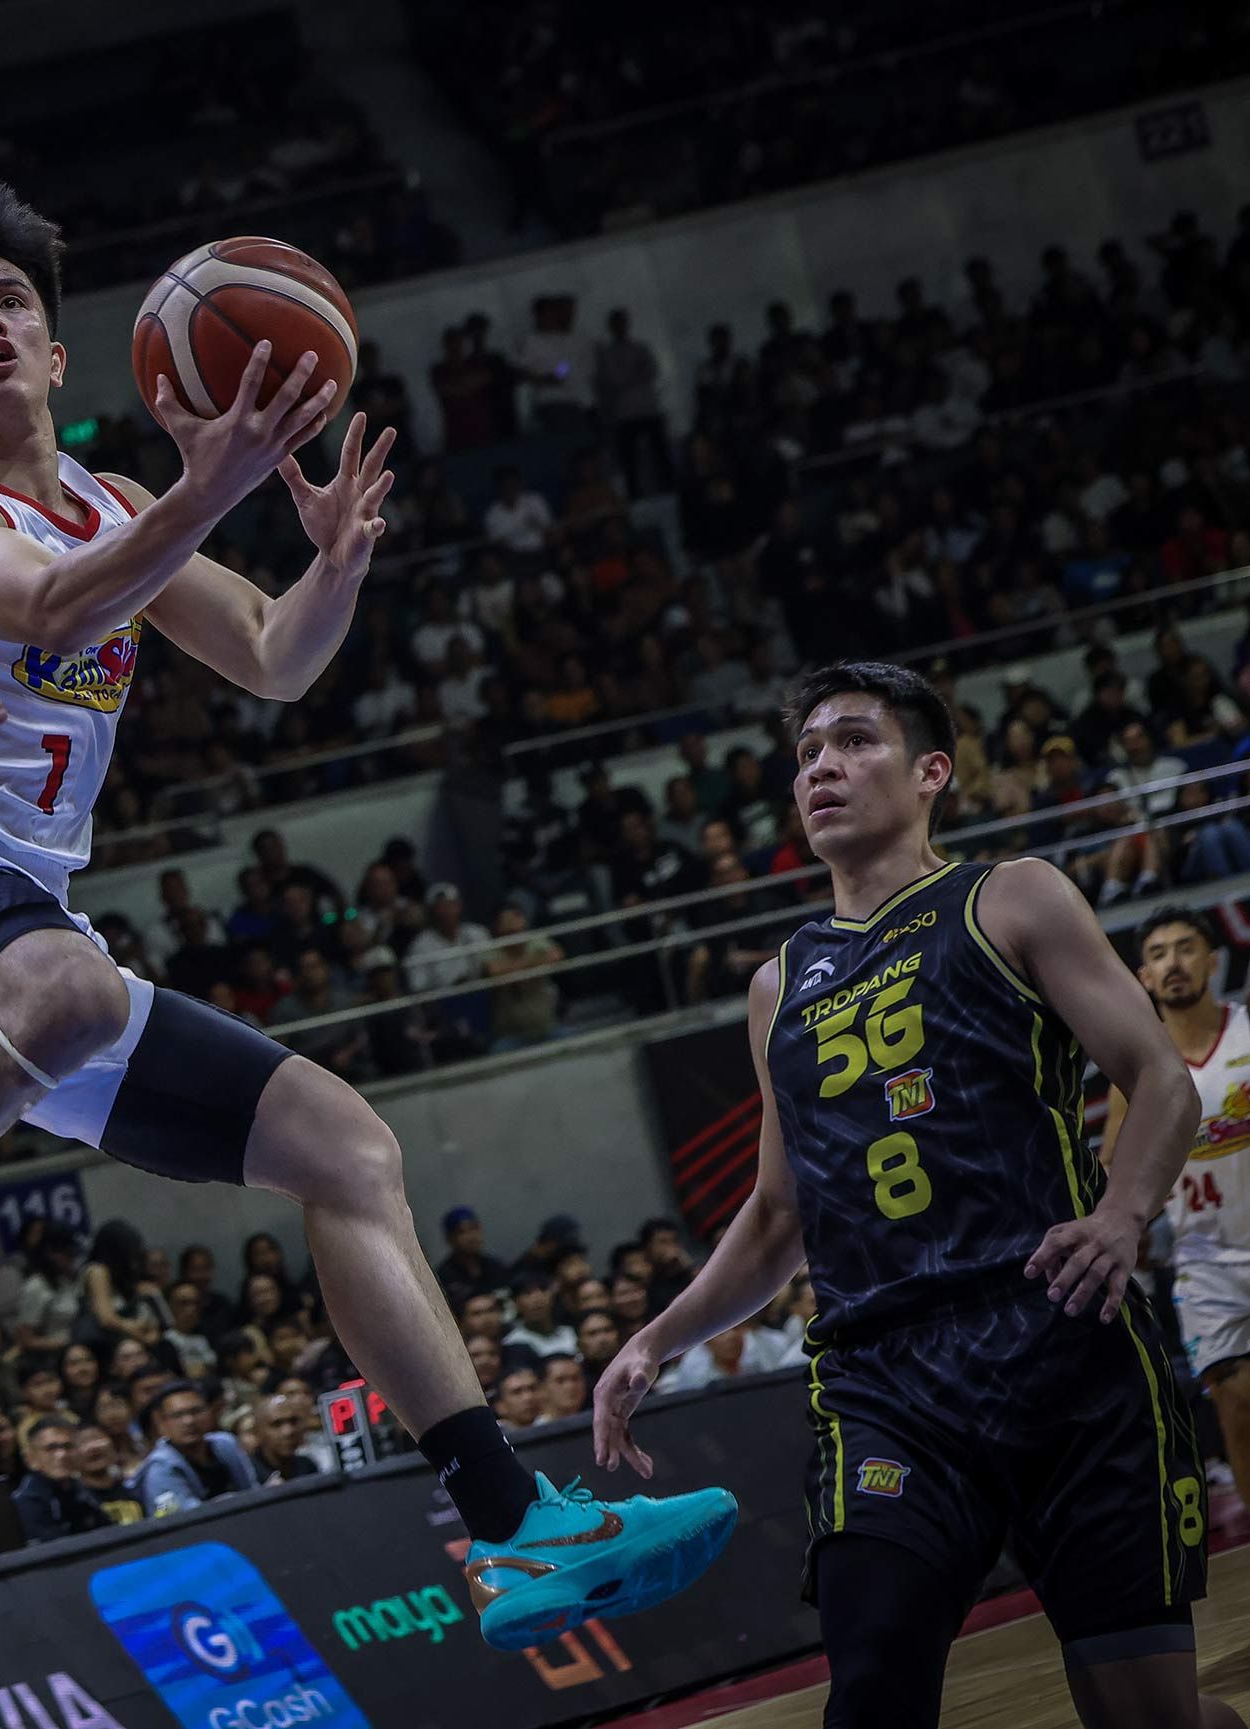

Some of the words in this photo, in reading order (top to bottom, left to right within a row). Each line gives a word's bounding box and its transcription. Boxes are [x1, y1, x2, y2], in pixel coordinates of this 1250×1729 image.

[37, 734, 72, 816] 1
[801, 951, 923, 1028] TROPANG
[803, 975, 926, 1099] 5G
[886, 1070, 933, 1118] TNT
[866, 1131, 934, 1221] 8
[1182, 1171, 1222, 1211] 24
[860, 1465, 907, 1489] TNT
[1172, 1475, 1204, 1547] 8
[332, 1584, 464, 1651] maya
